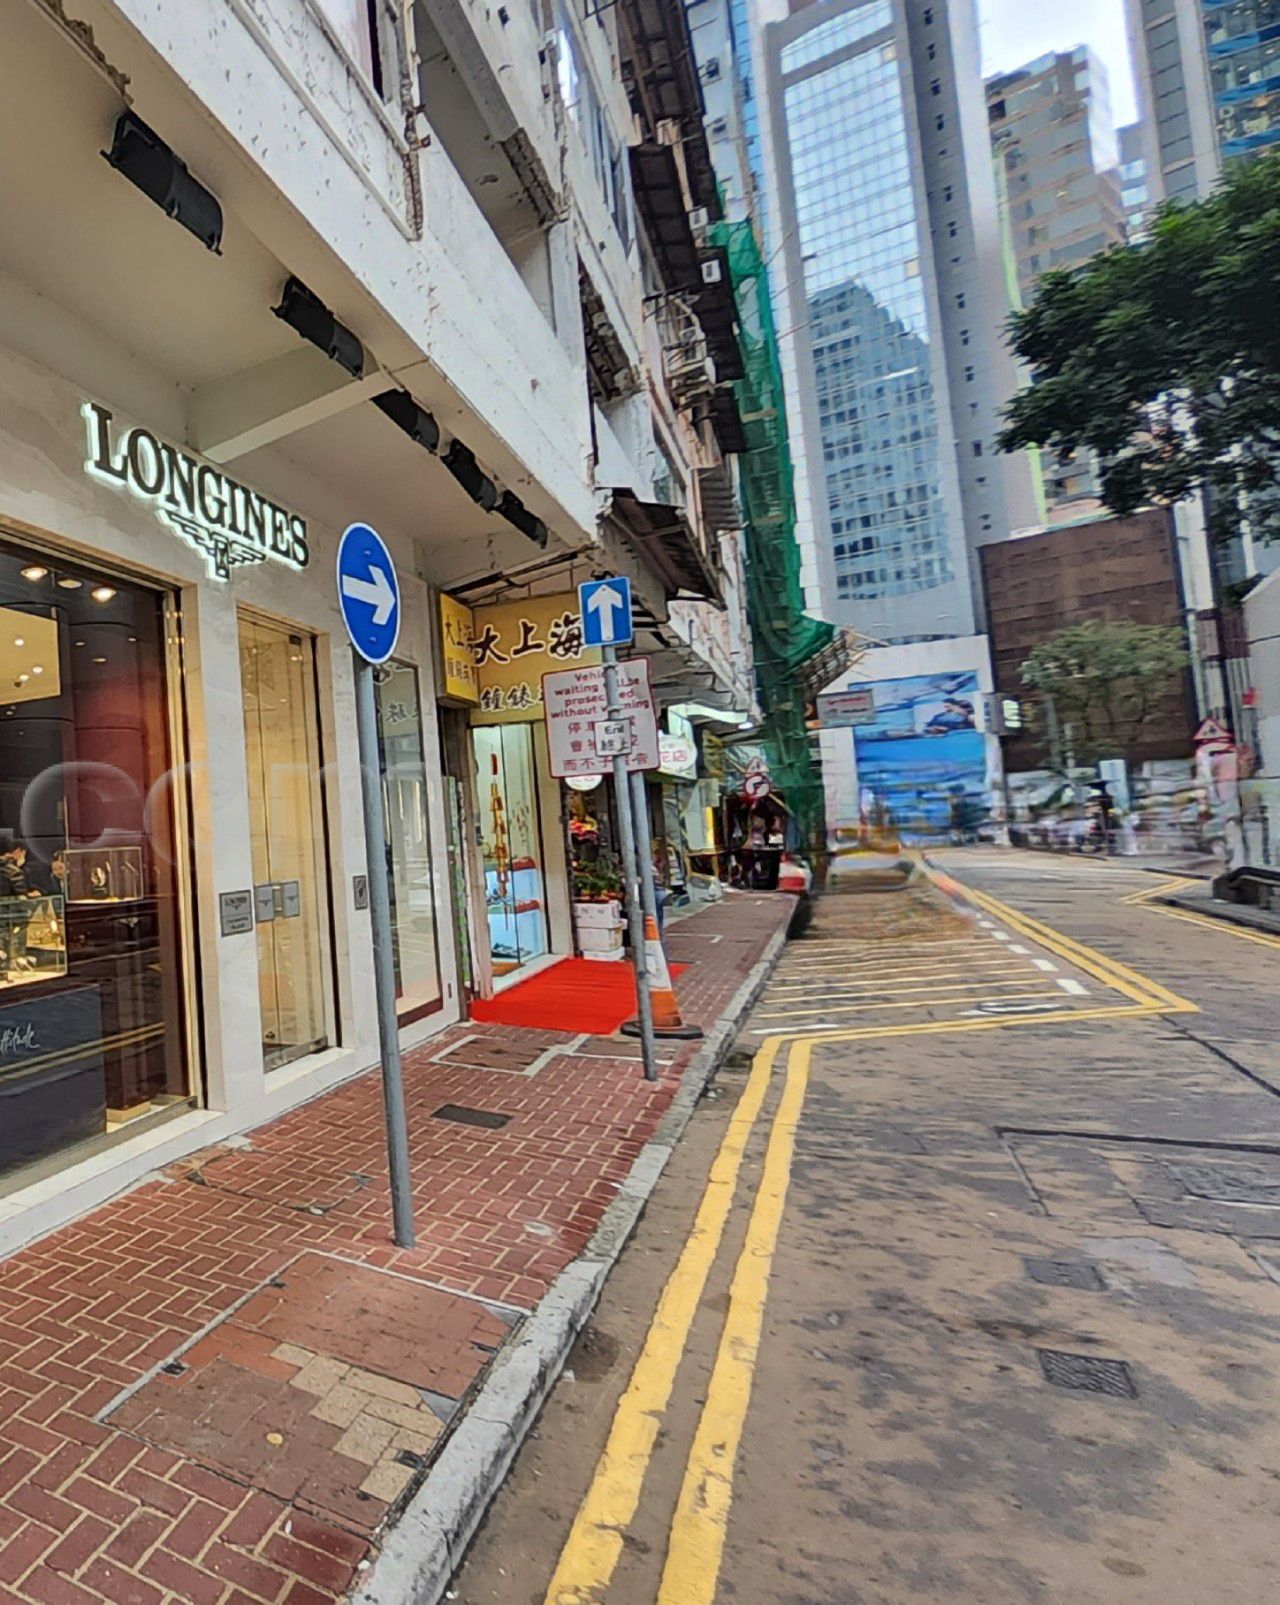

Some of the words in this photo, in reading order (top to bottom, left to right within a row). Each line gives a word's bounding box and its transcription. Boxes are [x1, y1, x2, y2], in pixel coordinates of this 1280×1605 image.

[82, 401, 310, 567] LONGINES
[474, 612, 584, 665] 大上海
[555, 684, 599, 696] waiting
[565, 690, 634, 708] proseced
[551, 706, 597, 719] without
[604, 723, 625, 734] End
